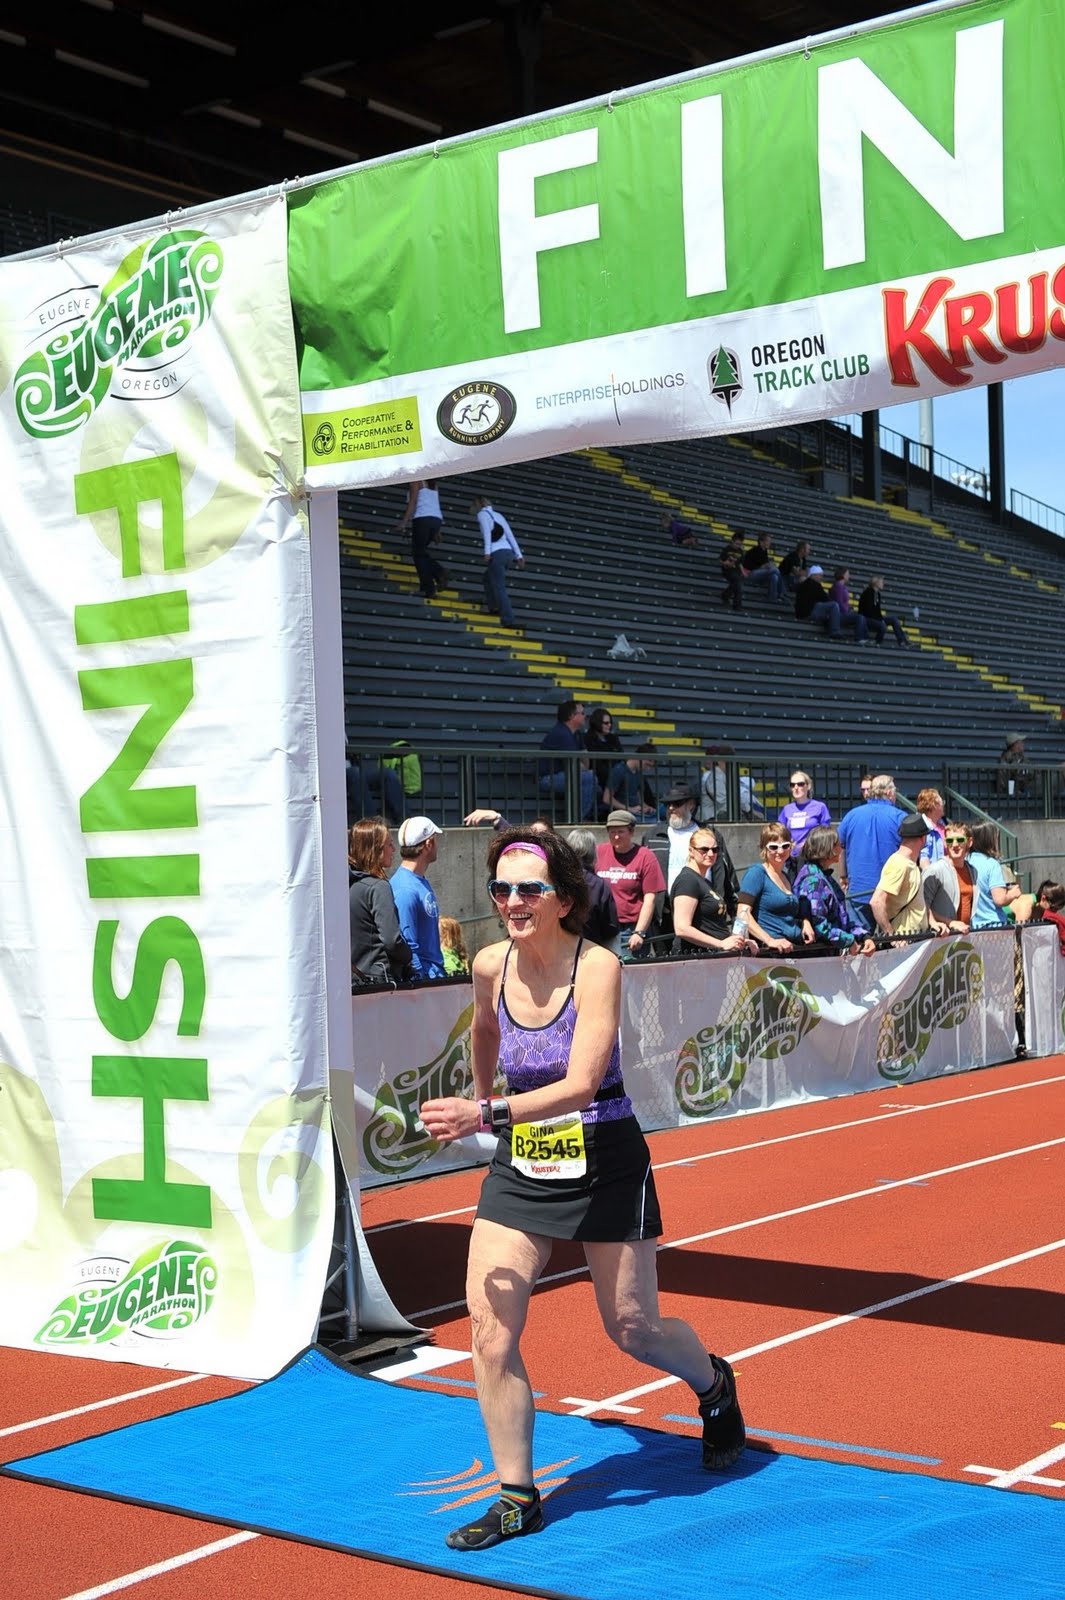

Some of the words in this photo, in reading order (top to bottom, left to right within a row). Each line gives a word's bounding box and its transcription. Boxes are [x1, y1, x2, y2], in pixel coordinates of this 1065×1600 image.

[39, 298, 91, 325] EUGENE
[53, 245, 194, 411] EUGENE
[117, 302, 195, 367] MARATHON
[750, 333, 826, 368] OREGON
[121, 371, 178, 390] OREGON
[753, 363, 816, 394] TRACK
[820, 353, 870, 383] CLUB
[452, 383, 497, 402] EUGENE
[405, 419, 414, 431] &
[449, 427, 478, 444] RUNNING
[479, 417, 506, 442] COMPANY
[74, 452, 213, 1229] FINISH
[883, 953, 967, 1054] EUGENE
[529, 1126, 555, 1138] GINA
[515, 1135, 581, 1160] B2545
[81, 1265, 121, 1277] EUGENE
[65, 1255, 199, 1338] EUGENE
[129, 1298, 196, 1329] MARATHON
